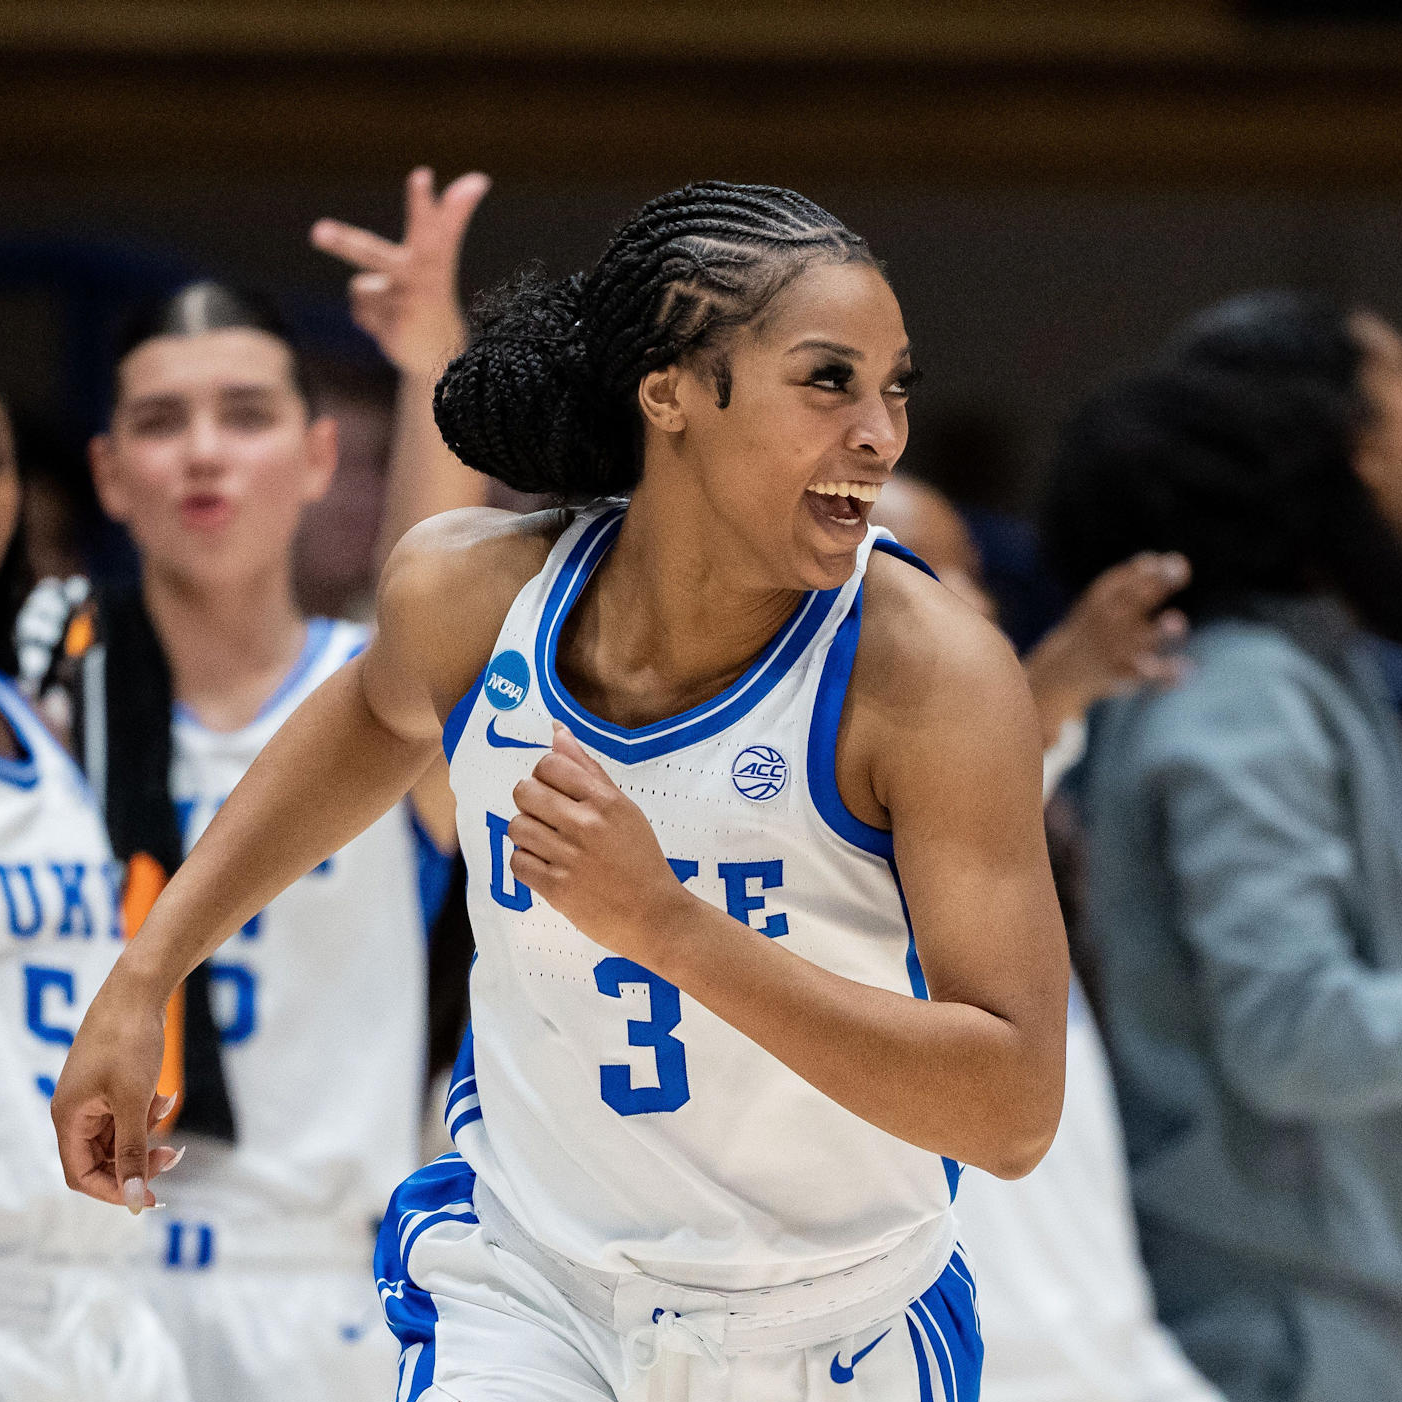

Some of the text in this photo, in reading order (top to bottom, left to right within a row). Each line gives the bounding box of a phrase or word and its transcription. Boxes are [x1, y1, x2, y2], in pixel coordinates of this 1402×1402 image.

[487, 672, 524, 702] NCAA
[738, 762, 786, 778] ACC
[486, 810, 789, 939] DE
[593, 957, 691, 1117] 3
